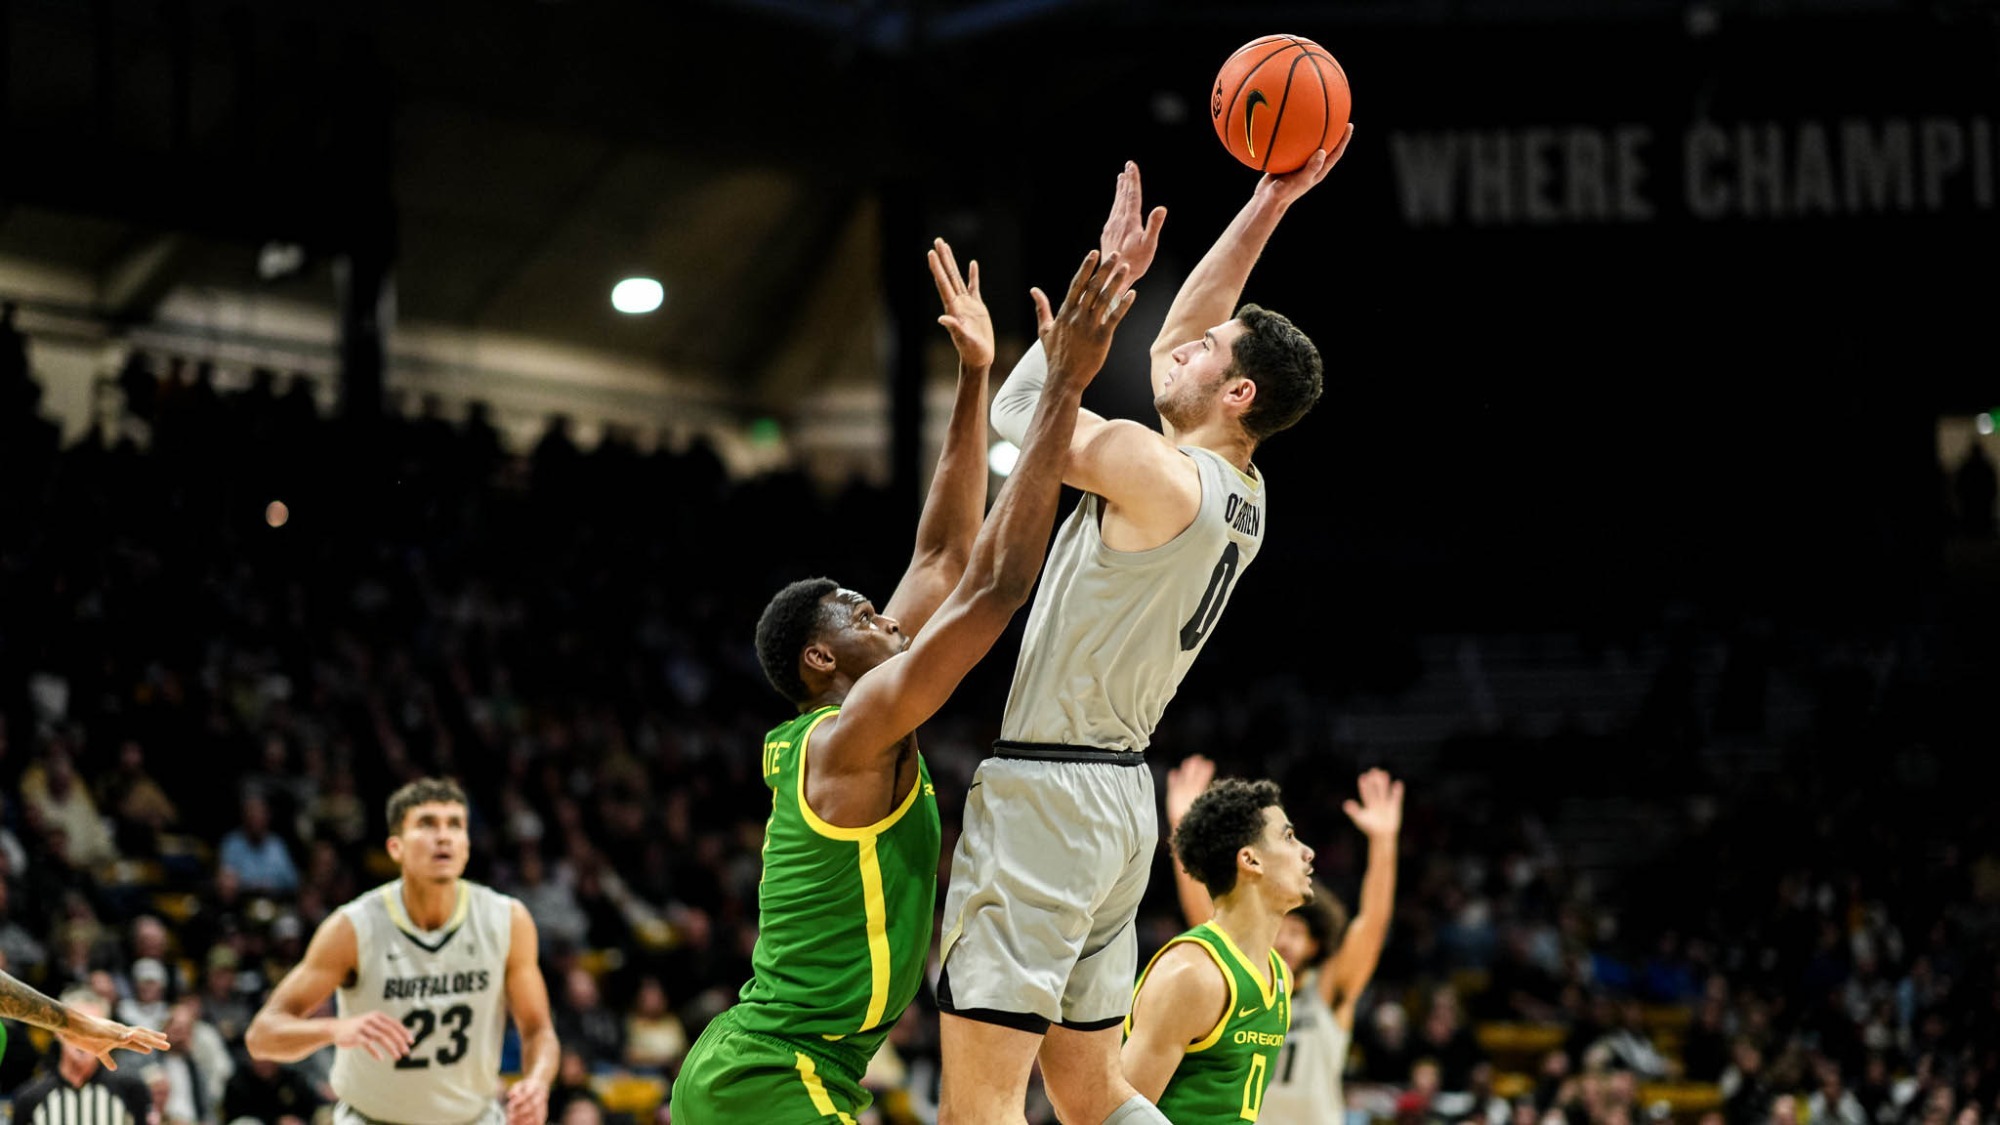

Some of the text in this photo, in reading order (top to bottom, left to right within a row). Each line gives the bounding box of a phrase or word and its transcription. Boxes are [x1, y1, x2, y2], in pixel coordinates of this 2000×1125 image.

[1391, 115, 1994, 227] WHERE CHAMPI
[1224, 493, 1260, 537] O'BRIEN
[1180, 540, 1239, 652] 0
[383, 969, 490, 999] BUFFALOES
[394, 1003, 473, 1069] 23
[1240, 1052, 1267, 1123] 0
